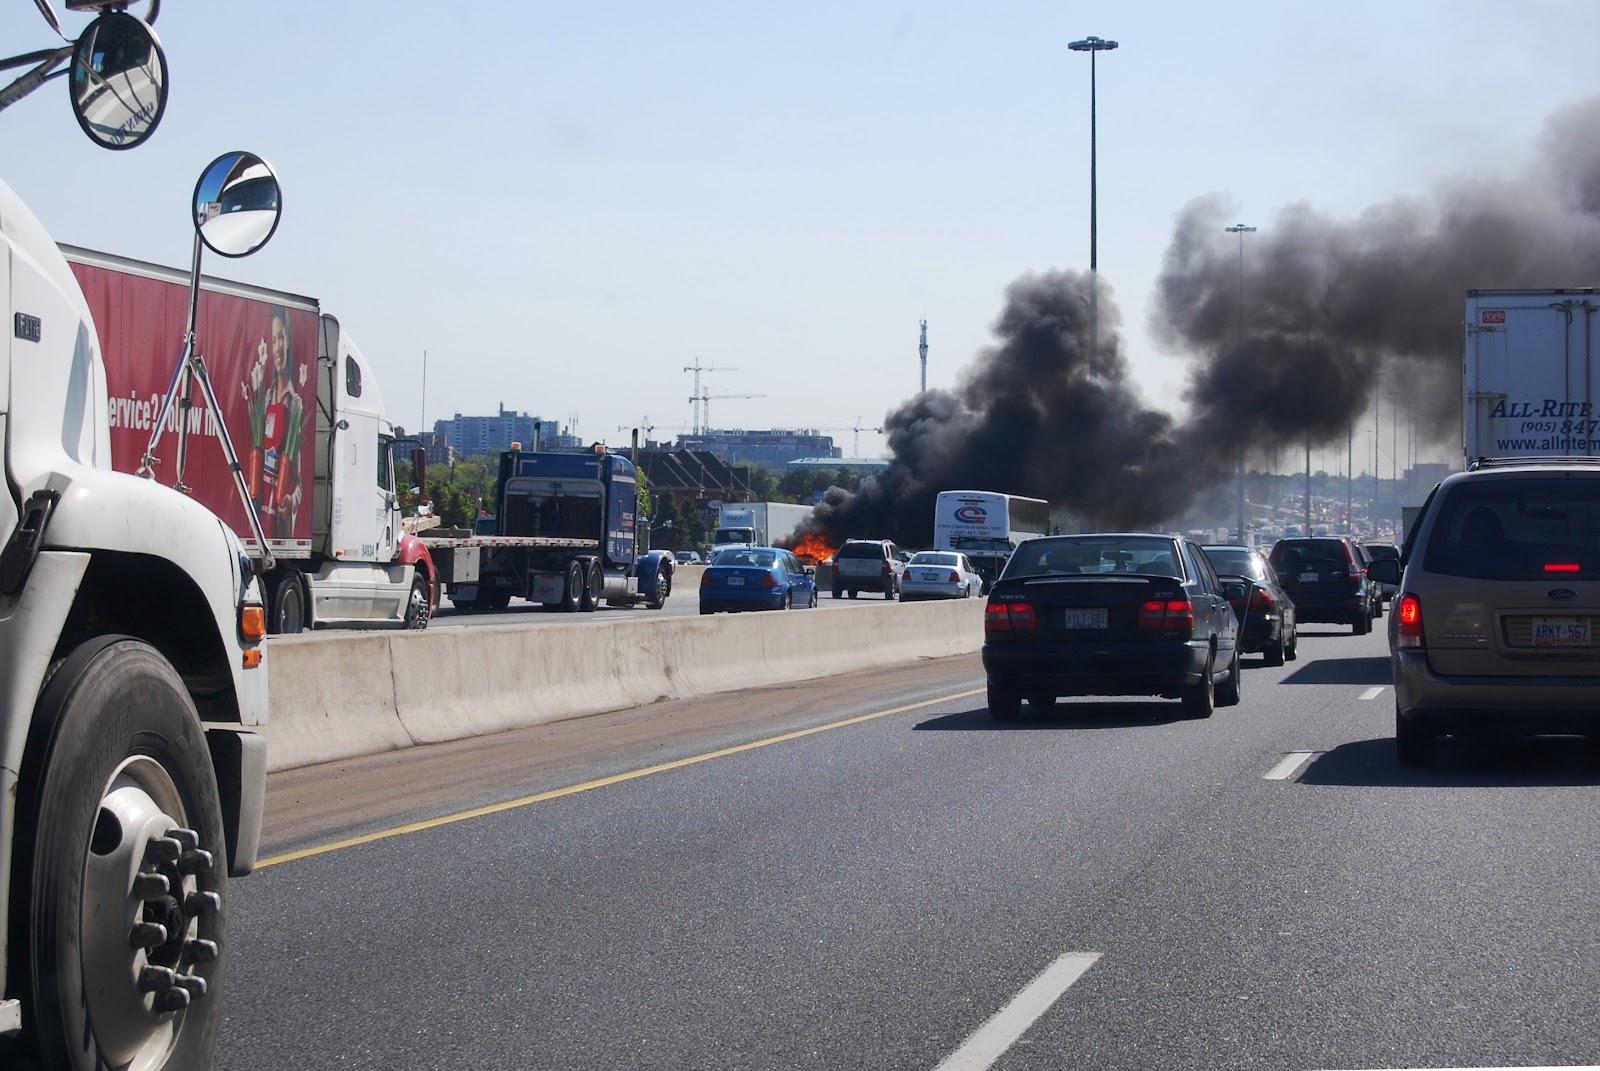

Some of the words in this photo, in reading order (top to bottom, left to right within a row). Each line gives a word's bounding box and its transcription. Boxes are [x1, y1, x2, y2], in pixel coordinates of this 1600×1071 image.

[161, 394, 202, 435] olow
[205, 407, 223, 436] m
[1489, 399, 1592, 418] ALL-RITE
[1521, 421, 1556, 433] (905)
[1560, 420, 1600, 434] 847
[1536, 624, 1561, 638] ARKY
[1568, 624, 1588, 639] 567
